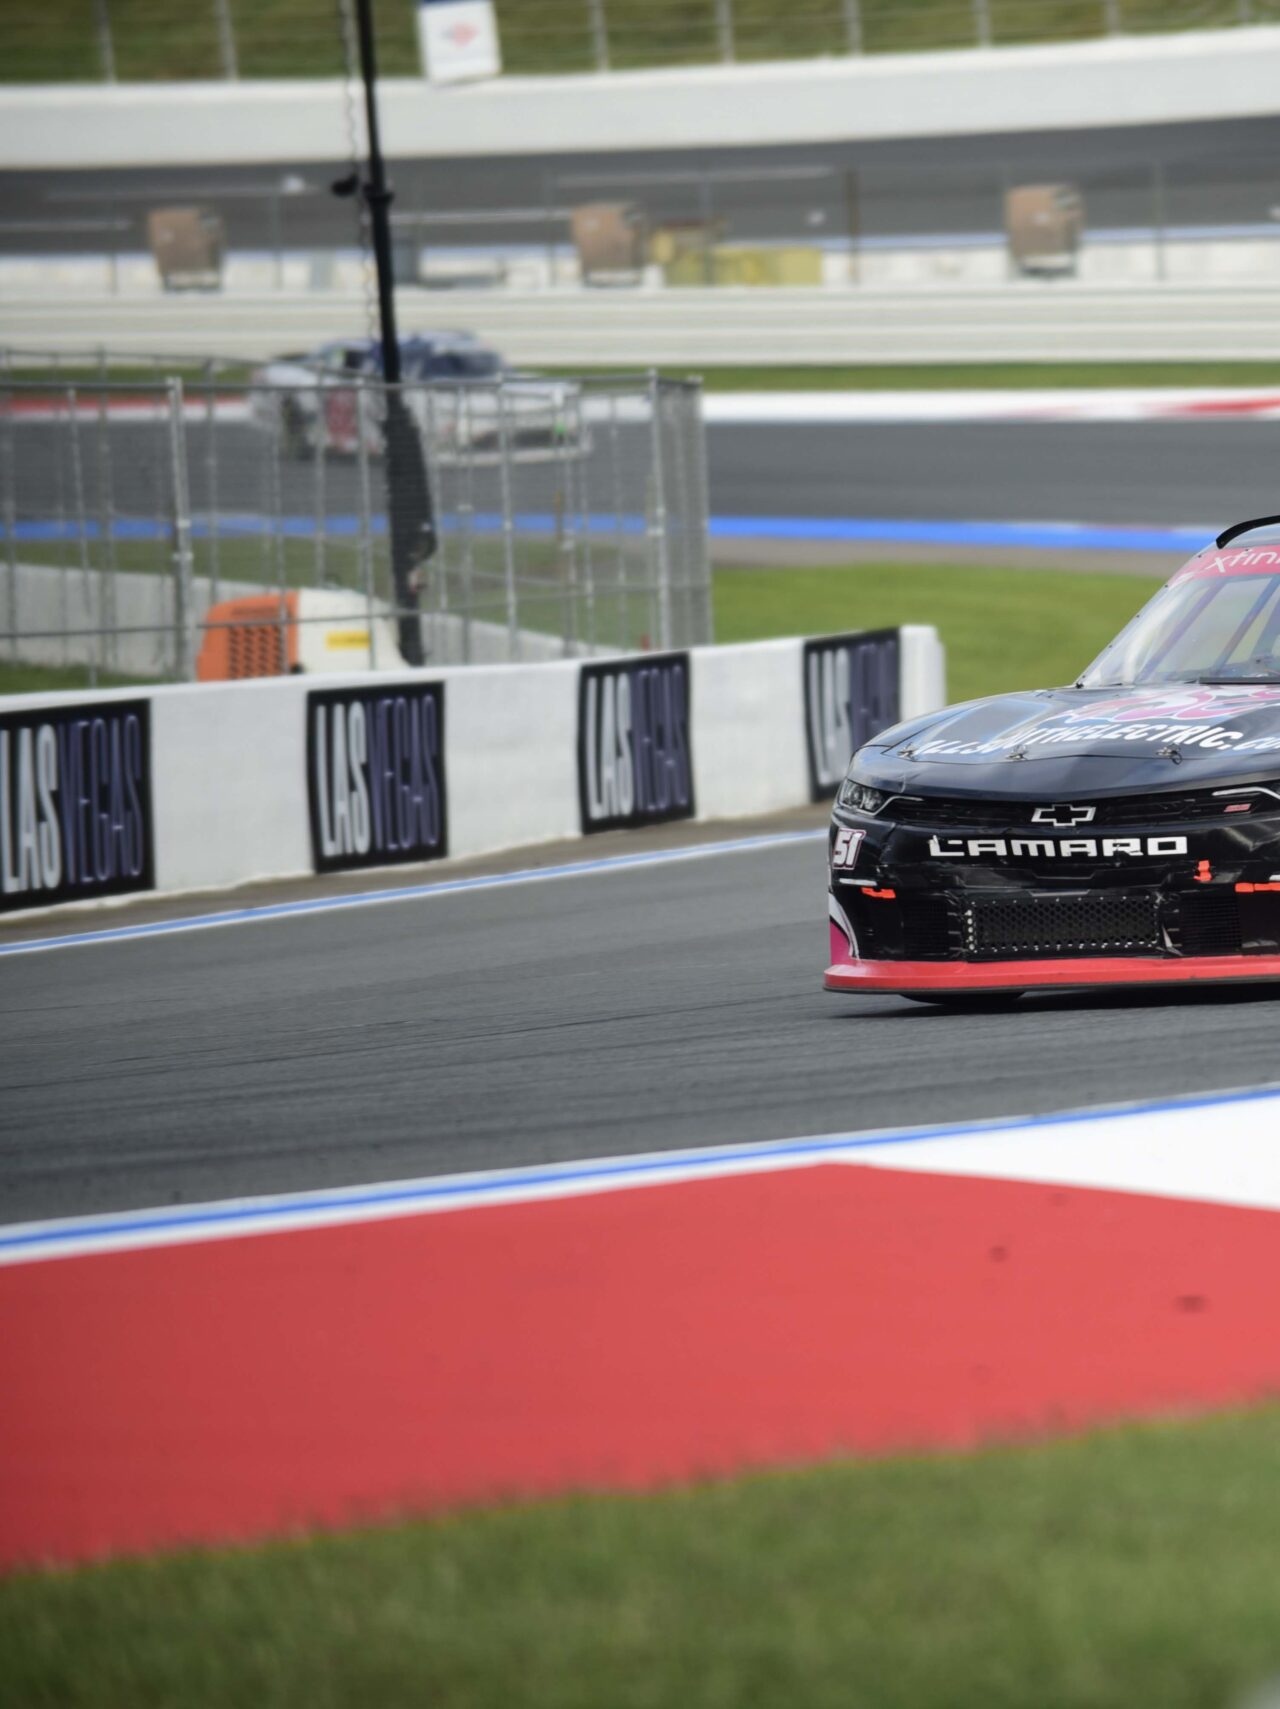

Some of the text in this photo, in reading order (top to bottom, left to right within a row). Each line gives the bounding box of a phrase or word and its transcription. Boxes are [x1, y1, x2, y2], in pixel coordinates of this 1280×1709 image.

[0, 713, 144, 893] LAS VEGAS
[316, 701, 371, 857] LAS
[587, 673, 634, 820] LAS
[833, 829, 866, 869] 51
[929, 836, 1187, 858] CAMARO
